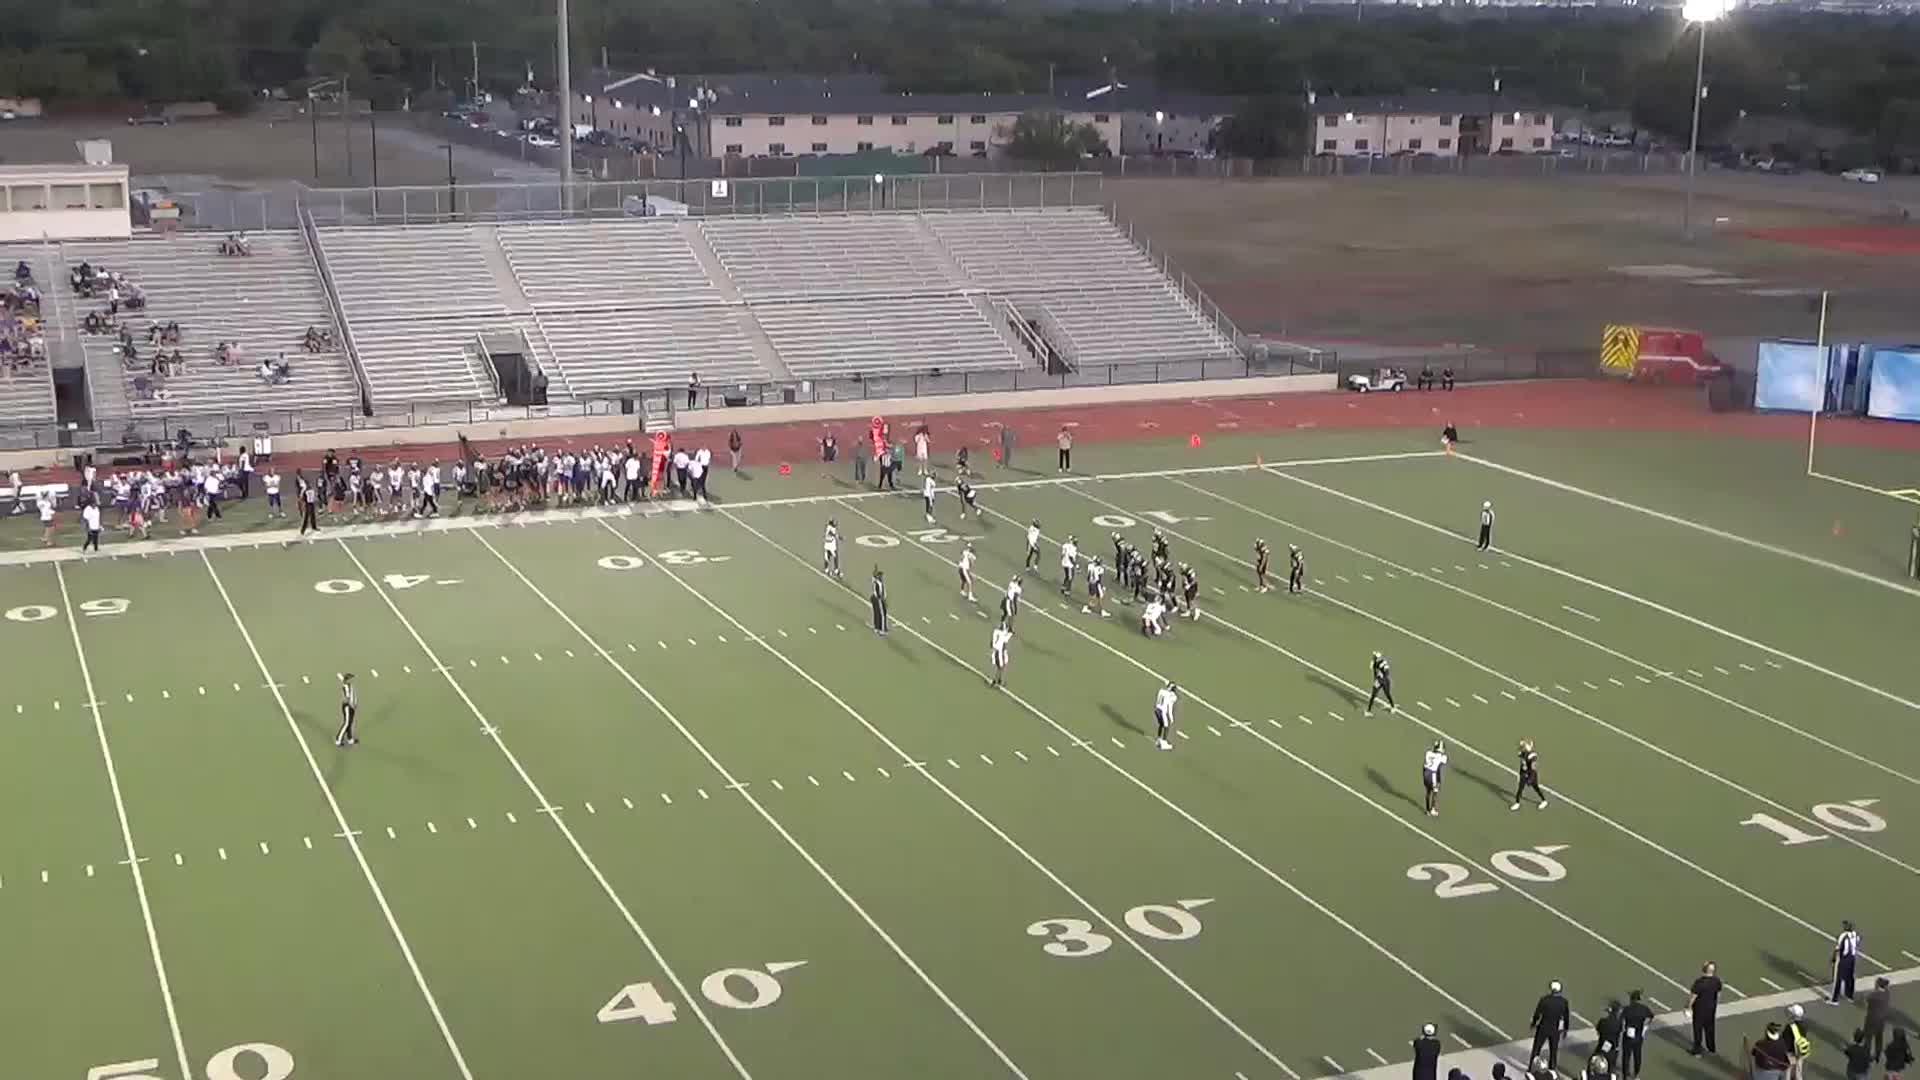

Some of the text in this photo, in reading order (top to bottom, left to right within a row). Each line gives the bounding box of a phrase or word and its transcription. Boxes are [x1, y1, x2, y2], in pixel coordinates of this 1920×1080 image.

[1092, 511, 1182, 528] 10
[597, 550, 708, 570] 30
[315, 574, 431, 594] 40
[4, 598, 131, 622] 50
[1740, 803, 1887, 845] 10
[1406, 850, 1568, 898] 20
[1026, 904, 1203, 957] 30
[596, 968, 783, 1025] 40
